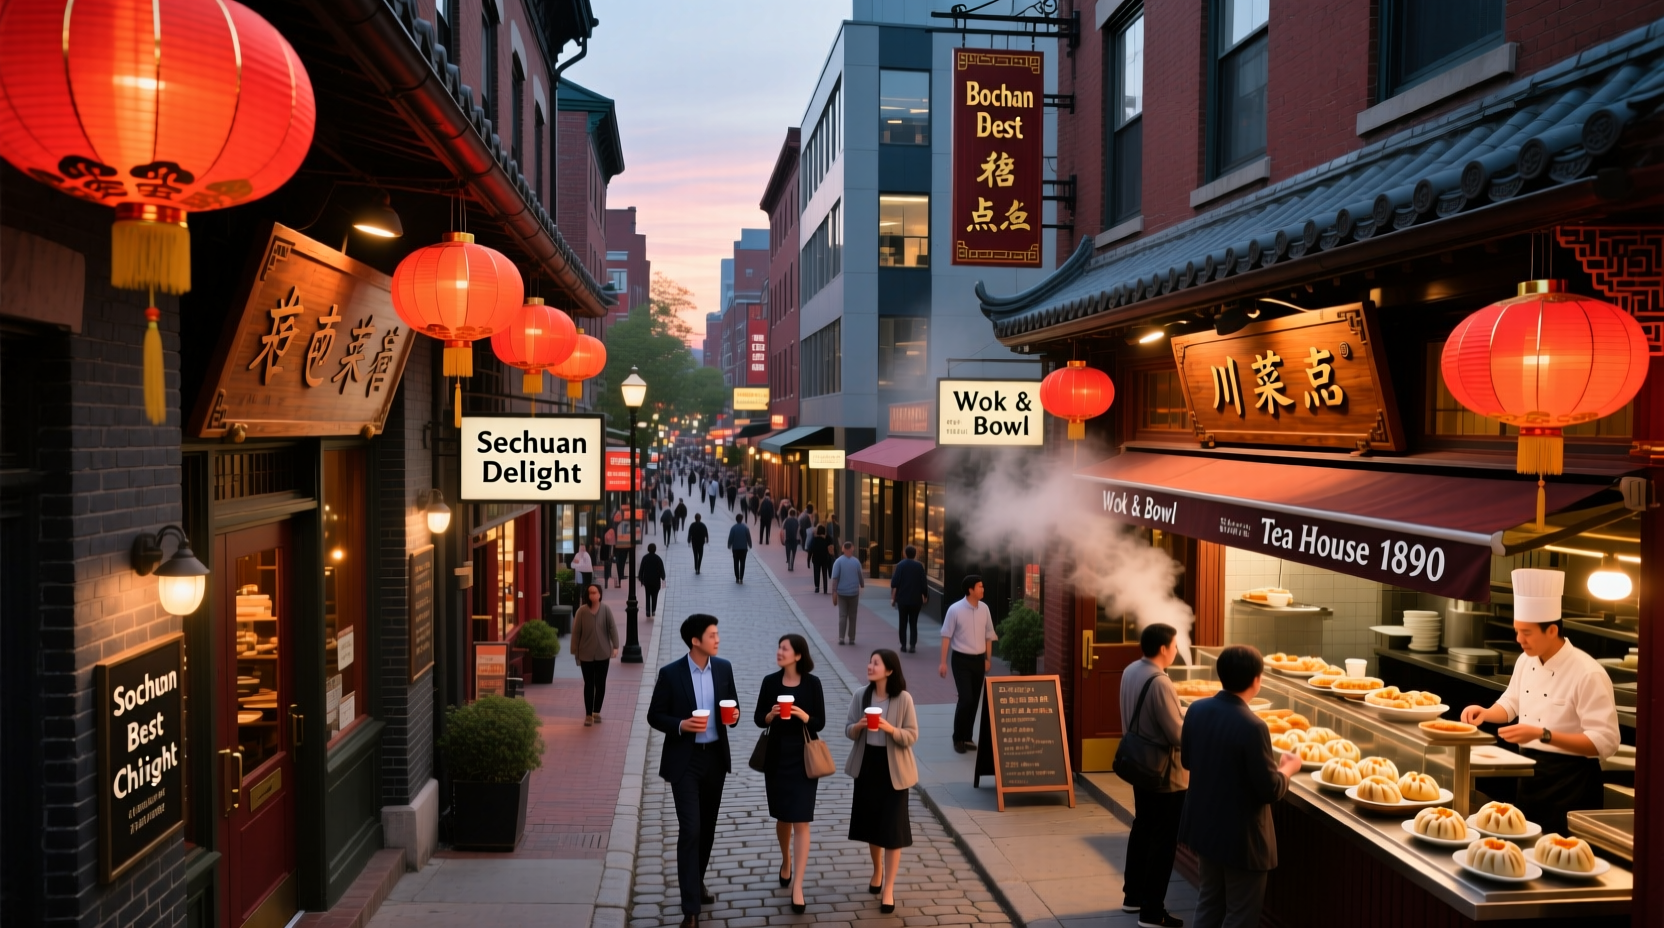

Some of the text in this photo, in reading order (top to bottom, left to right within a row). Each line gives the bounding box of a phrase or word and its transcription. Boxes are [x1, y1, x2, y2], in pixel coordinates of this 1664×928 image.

[966, 81, 1034, 108] Bochan
[953, 390, 1032, 412] Wok &
[974, 415, 1029, 436] Bowl
[477, 430, 587, 454] Sechuan
[483, 460, 582, 491] Delight
[1103, 490, 1177, 525] Wok & Bowl
[1261, 517, 1293, 550] Tea
[1299, 524, 1370, 566] House
[1380, 539, 1446, 582] 1890
[127, 712, 164, 752] Best
